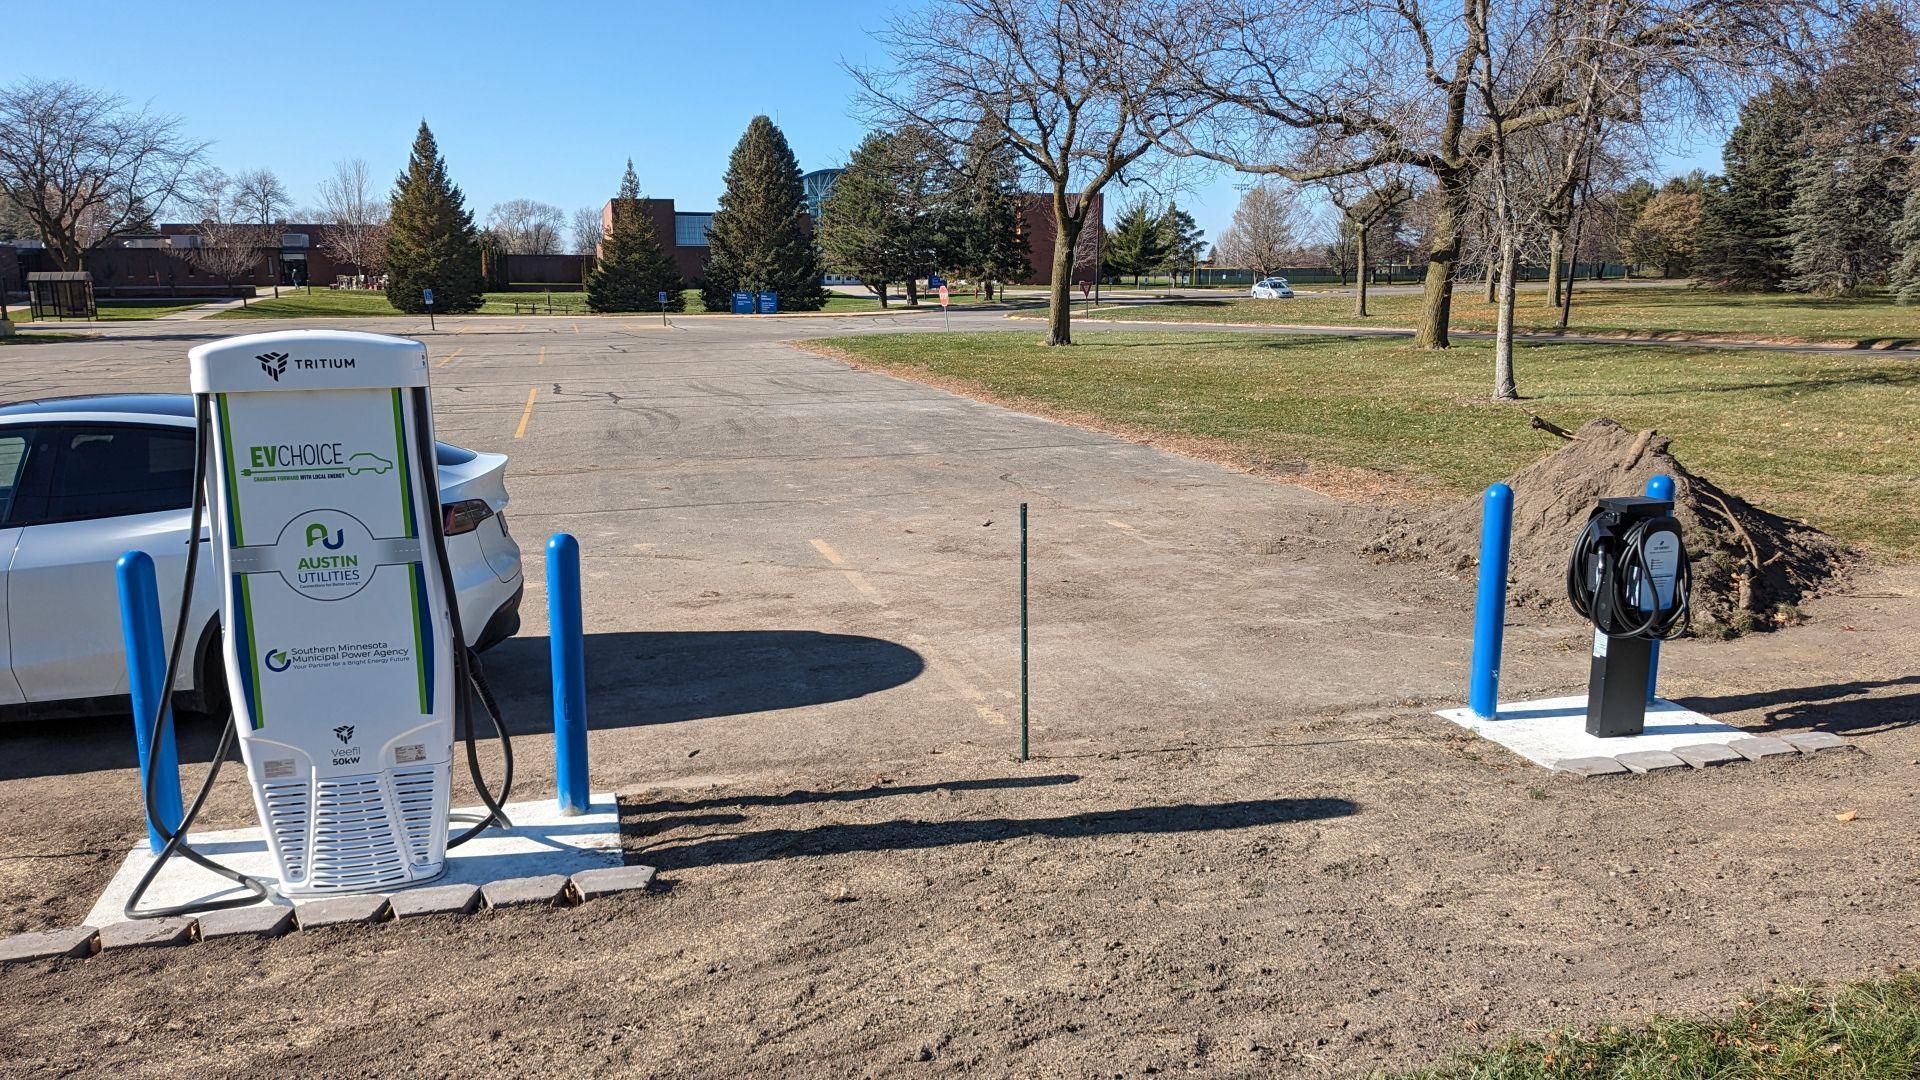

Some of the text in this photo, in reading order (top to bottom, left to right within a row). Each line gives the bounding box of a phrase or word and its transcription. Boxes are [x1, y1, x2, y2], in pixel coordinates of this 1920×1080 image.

[294, 358, 355, 369] TRITIUM
[298, 555, 358, 570] AUSTIN
[298, 570, 360, 583] UTILITIES
[291, 642, 388, 655] Southern Minnesota
[292, 648, 409, 663] Municipal Power Agency
[330, 746, 360, 757] Veefil
[332, 757, 360, 766] 50kW
